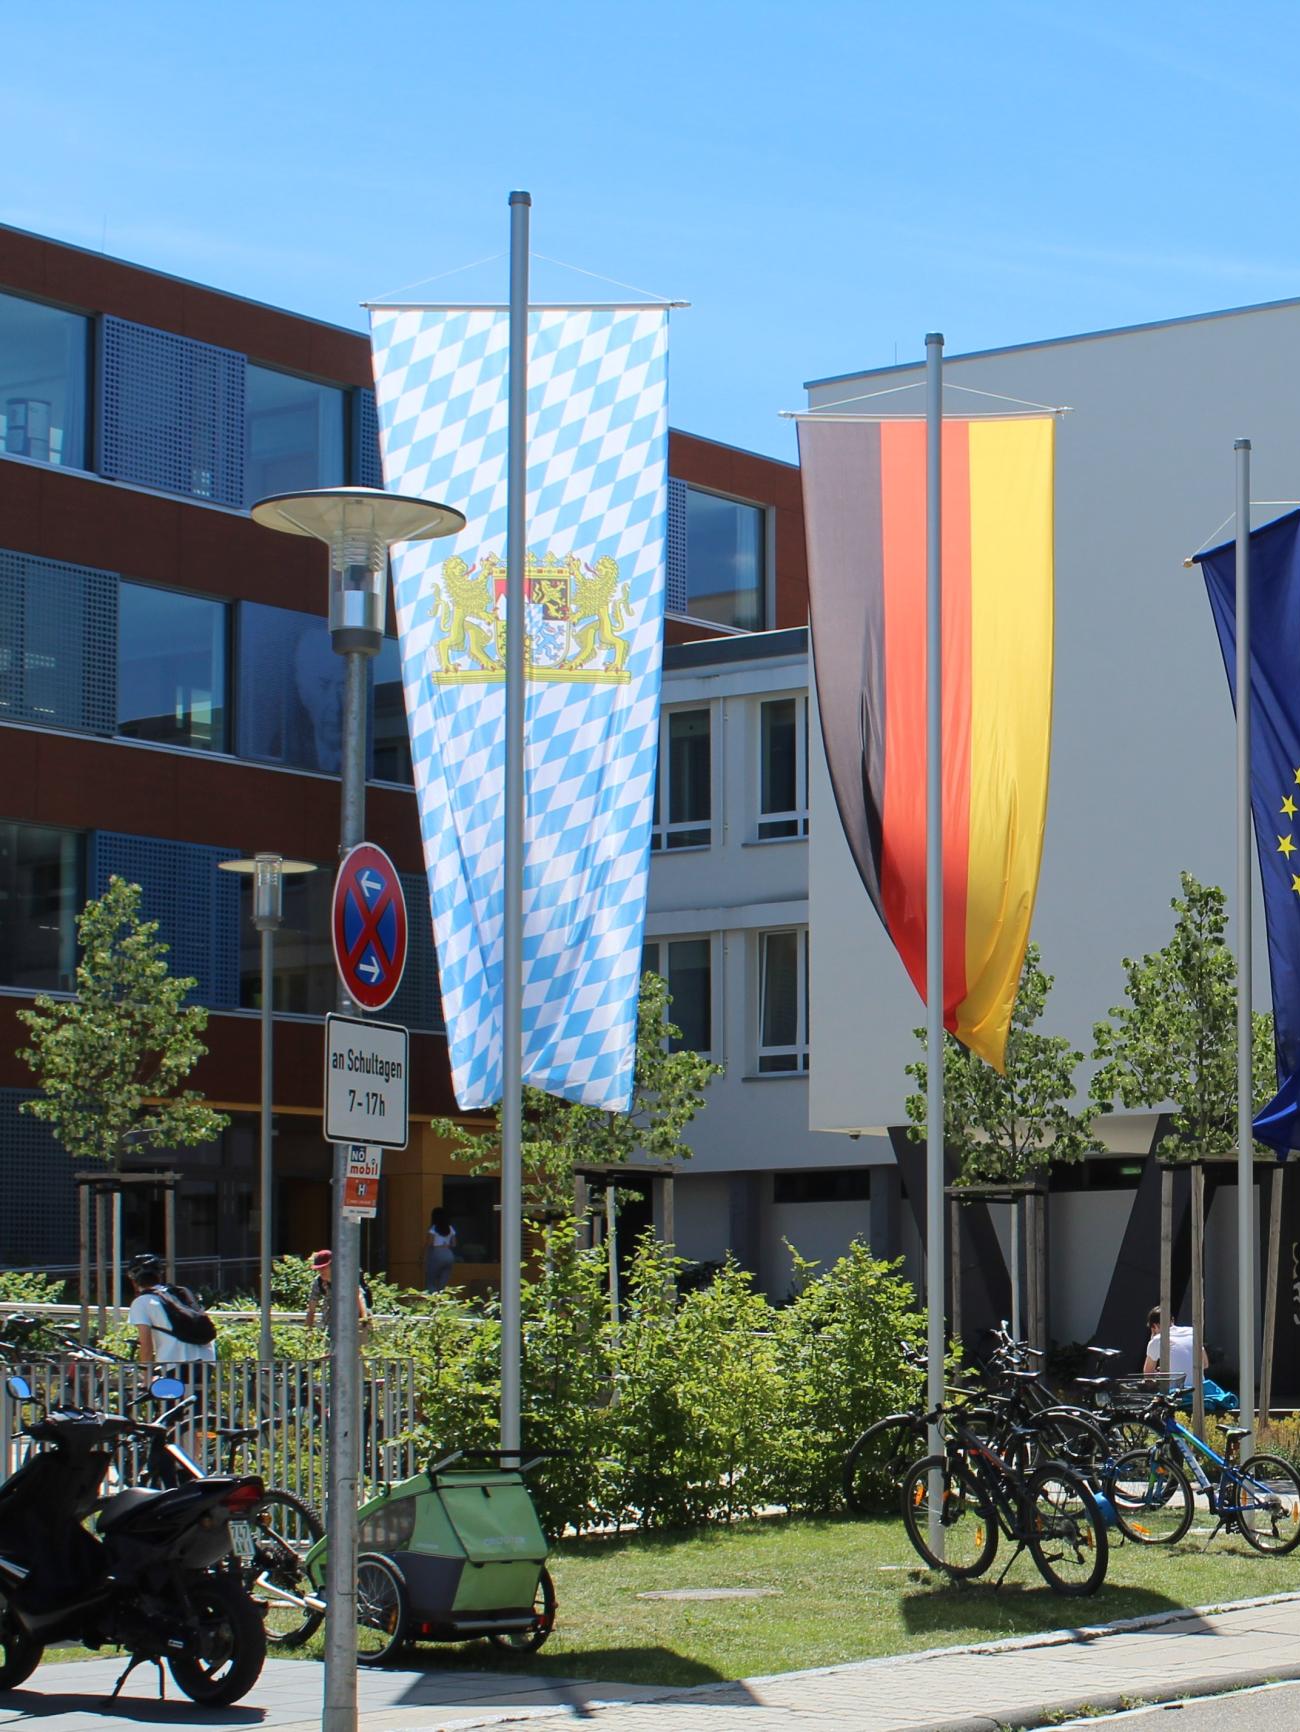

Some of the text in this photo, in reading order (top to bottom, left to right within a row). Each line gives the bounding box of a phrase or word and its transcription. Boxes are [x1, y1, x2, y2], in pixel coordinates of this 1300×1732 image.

[332, 1048, 402, 1083] an Schultagen
[350, 1162, 378, 1175] mobil
